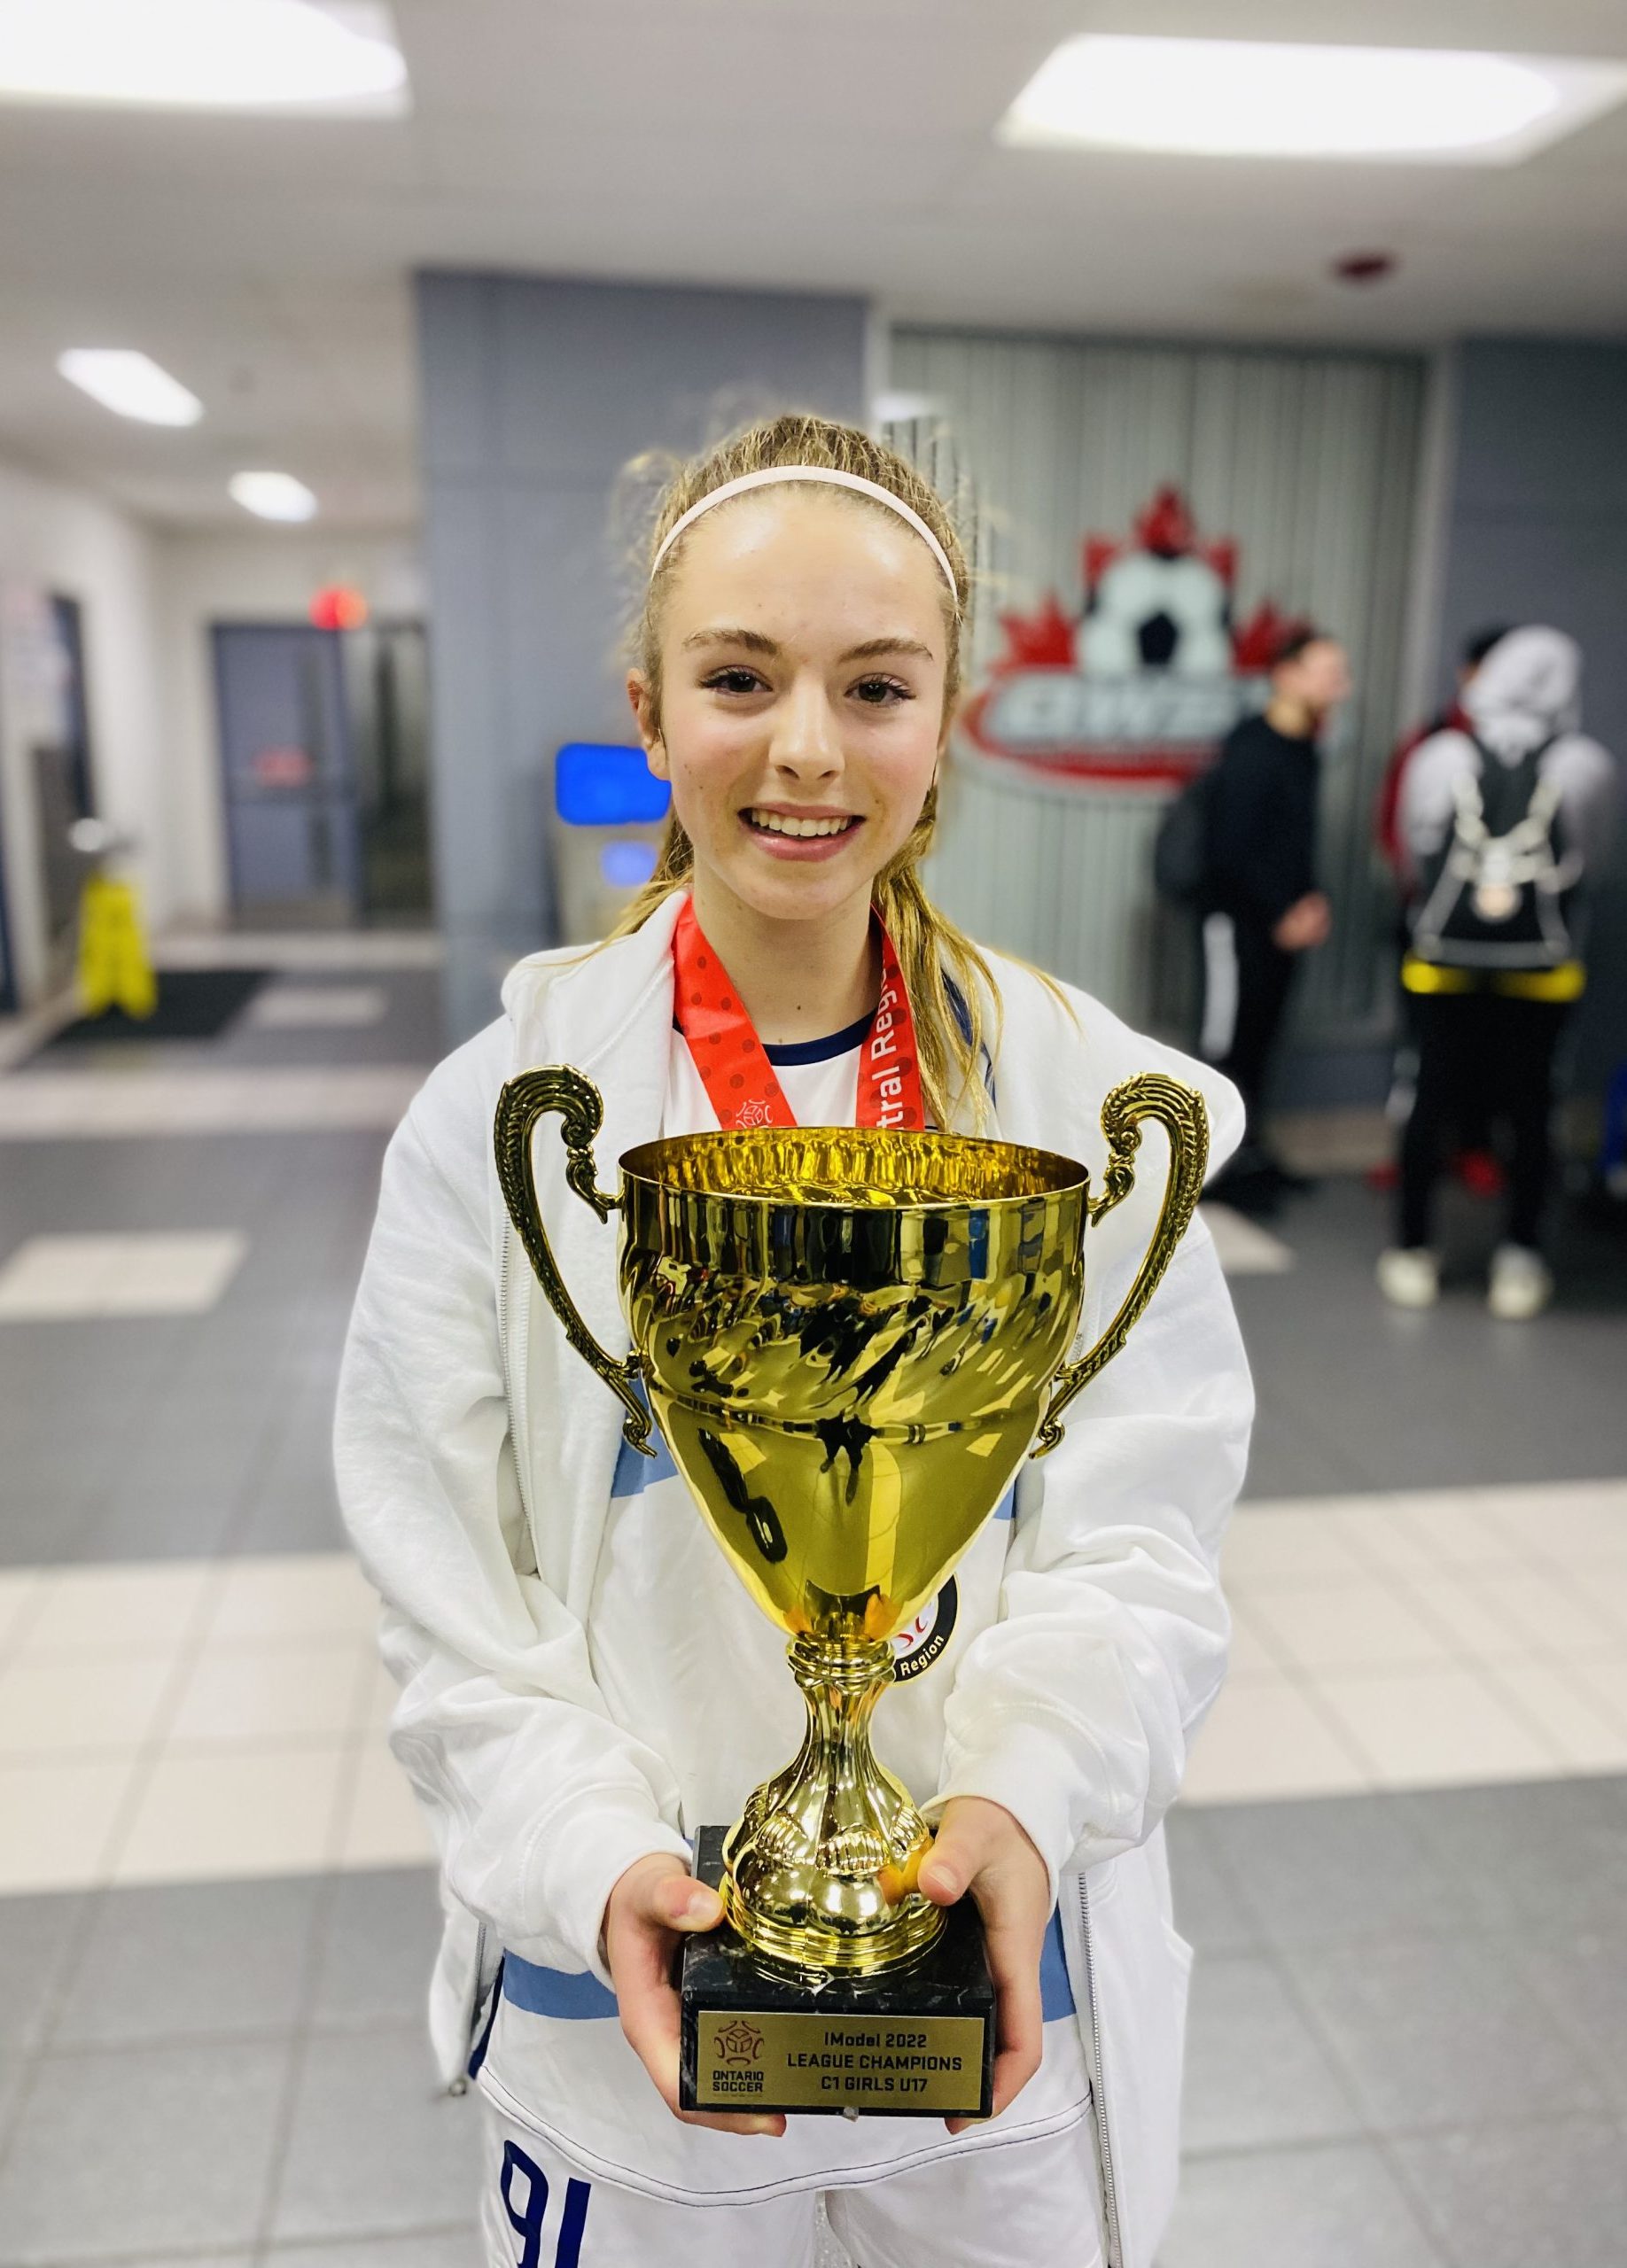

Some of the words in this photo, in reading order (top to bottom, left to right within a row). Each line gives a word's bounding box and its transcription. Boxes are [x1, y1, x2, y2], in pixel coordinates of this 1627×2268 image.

[871, 1066, 904, 1130] tral
[899, 1635, 945, 1677] Region
[885, 2033, 927, 2048] 2022
[787, 2053, 854, 2069] LEAGUE
[860, 2054, 962, 2071] CHAMPIONS
[712, 2070, 765, 2081] ONTARIO
[712, 2081, 763, 2093] SOCCER
[821, 2076, 839, 2091] C1
[845, 2077, 894, 2092] GIRLS
[899, 2078, 928, 2093] U17
[500, 2140, 592, 2268] 91
